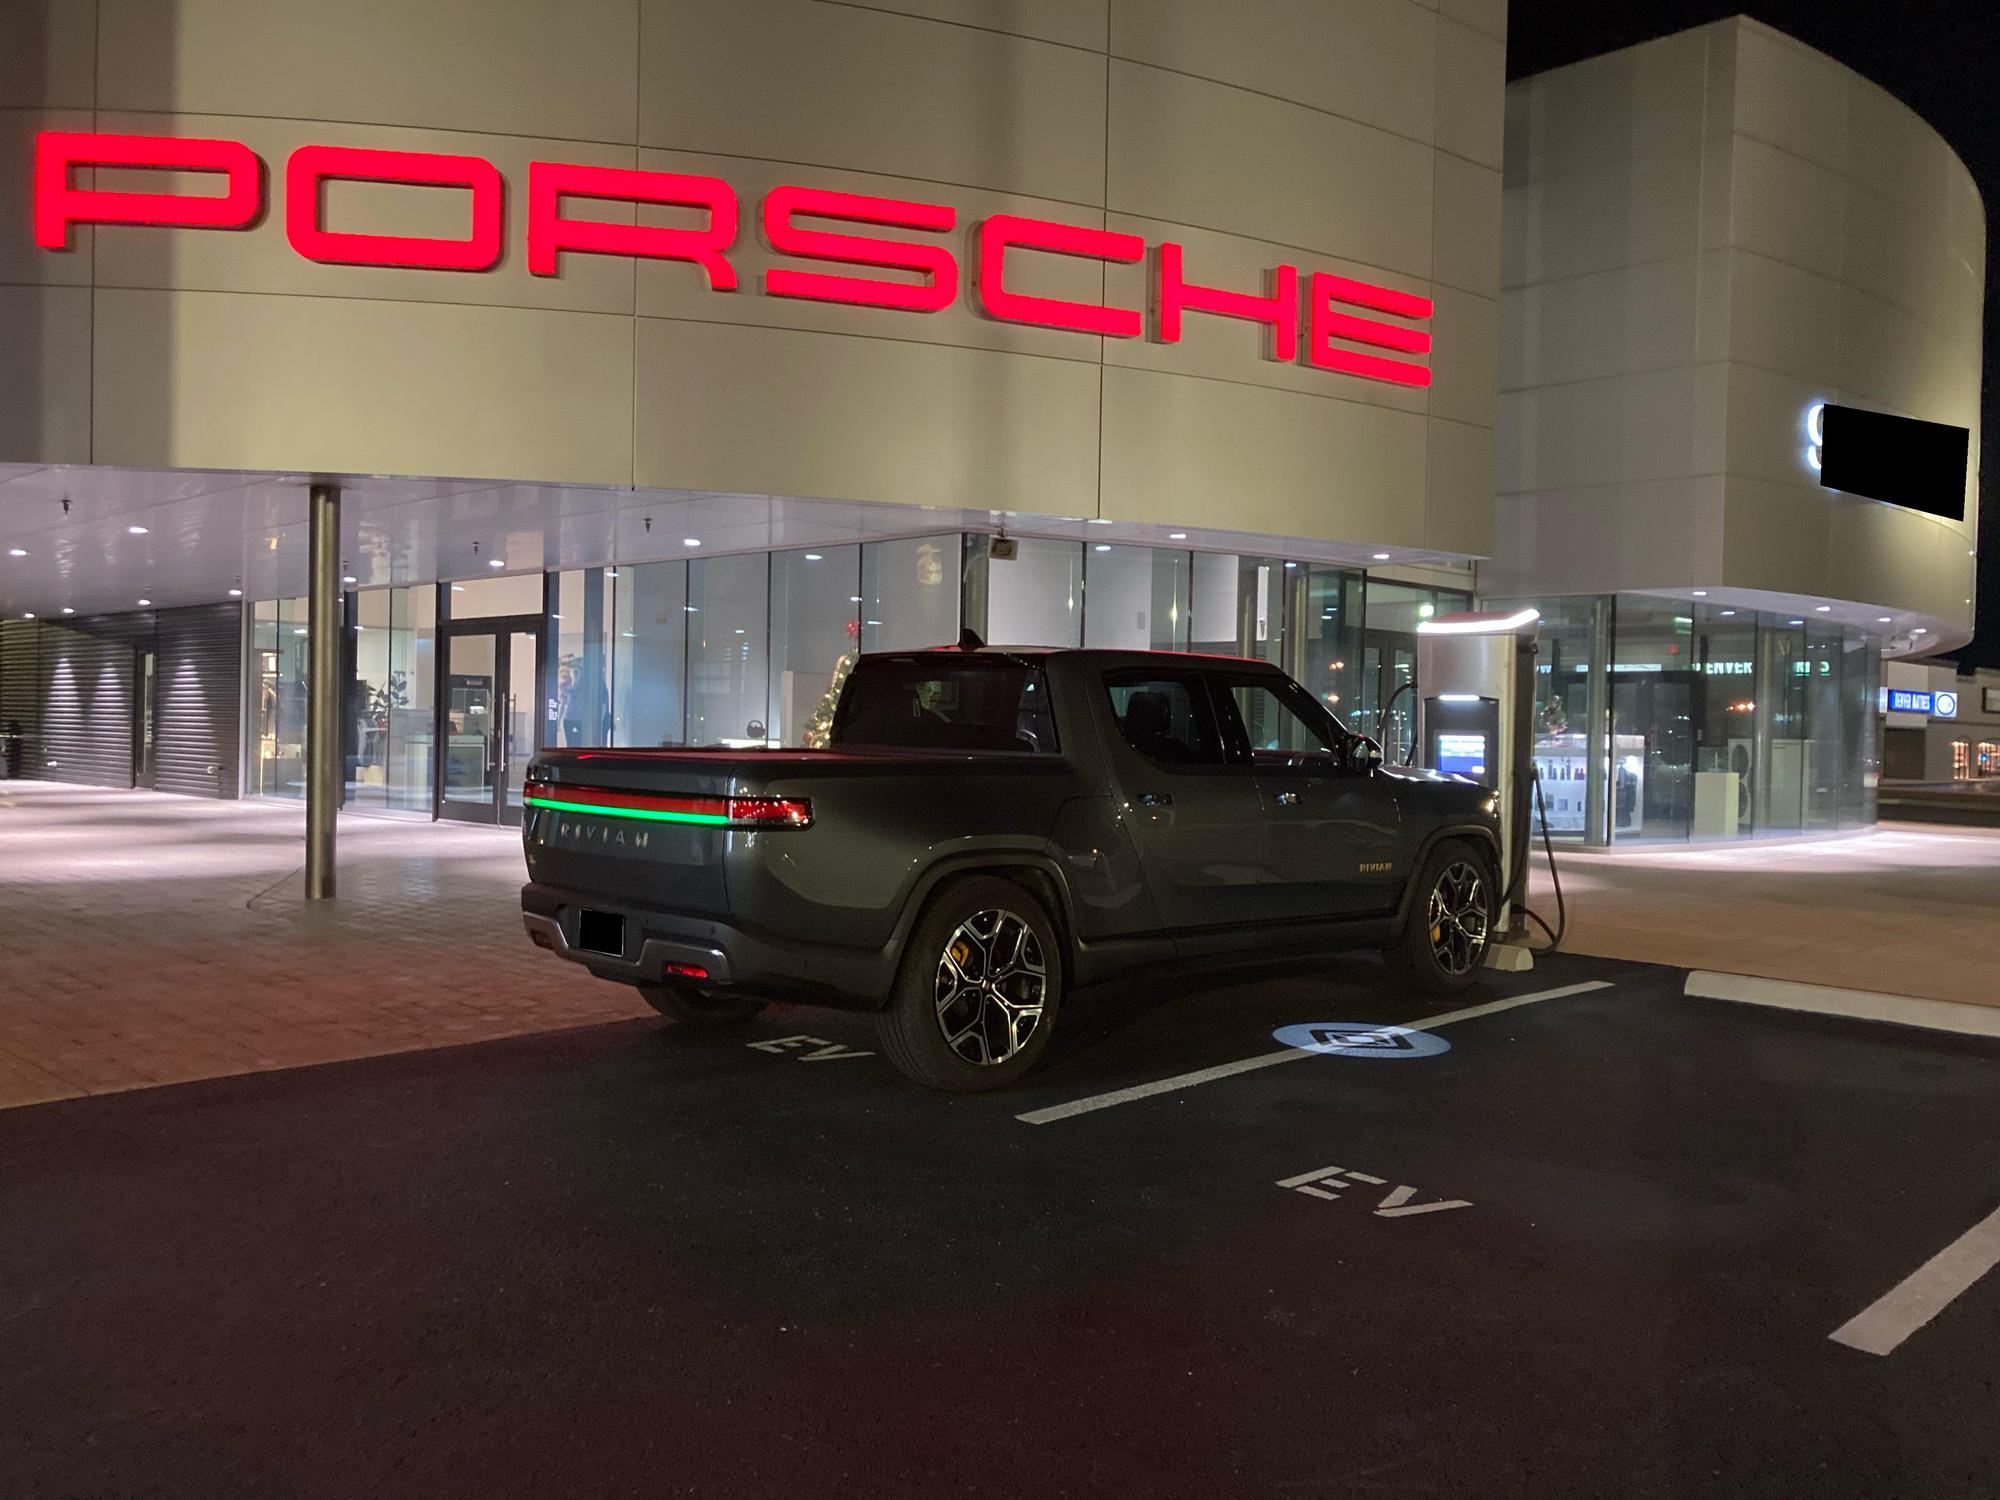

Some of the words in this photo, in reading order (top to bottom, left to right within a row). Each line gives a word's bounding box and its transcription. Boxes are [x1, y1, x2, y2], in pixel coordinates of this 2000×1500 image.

[34, 131, 1433, 387] PORSCHE
[561, 822, 649, 848] RIVIAN
[1360, 862, 1392, 872] RIVIAN
[746, 1035, 875, 1061] EV
[1275, 1166, 1474, 1217] EV
